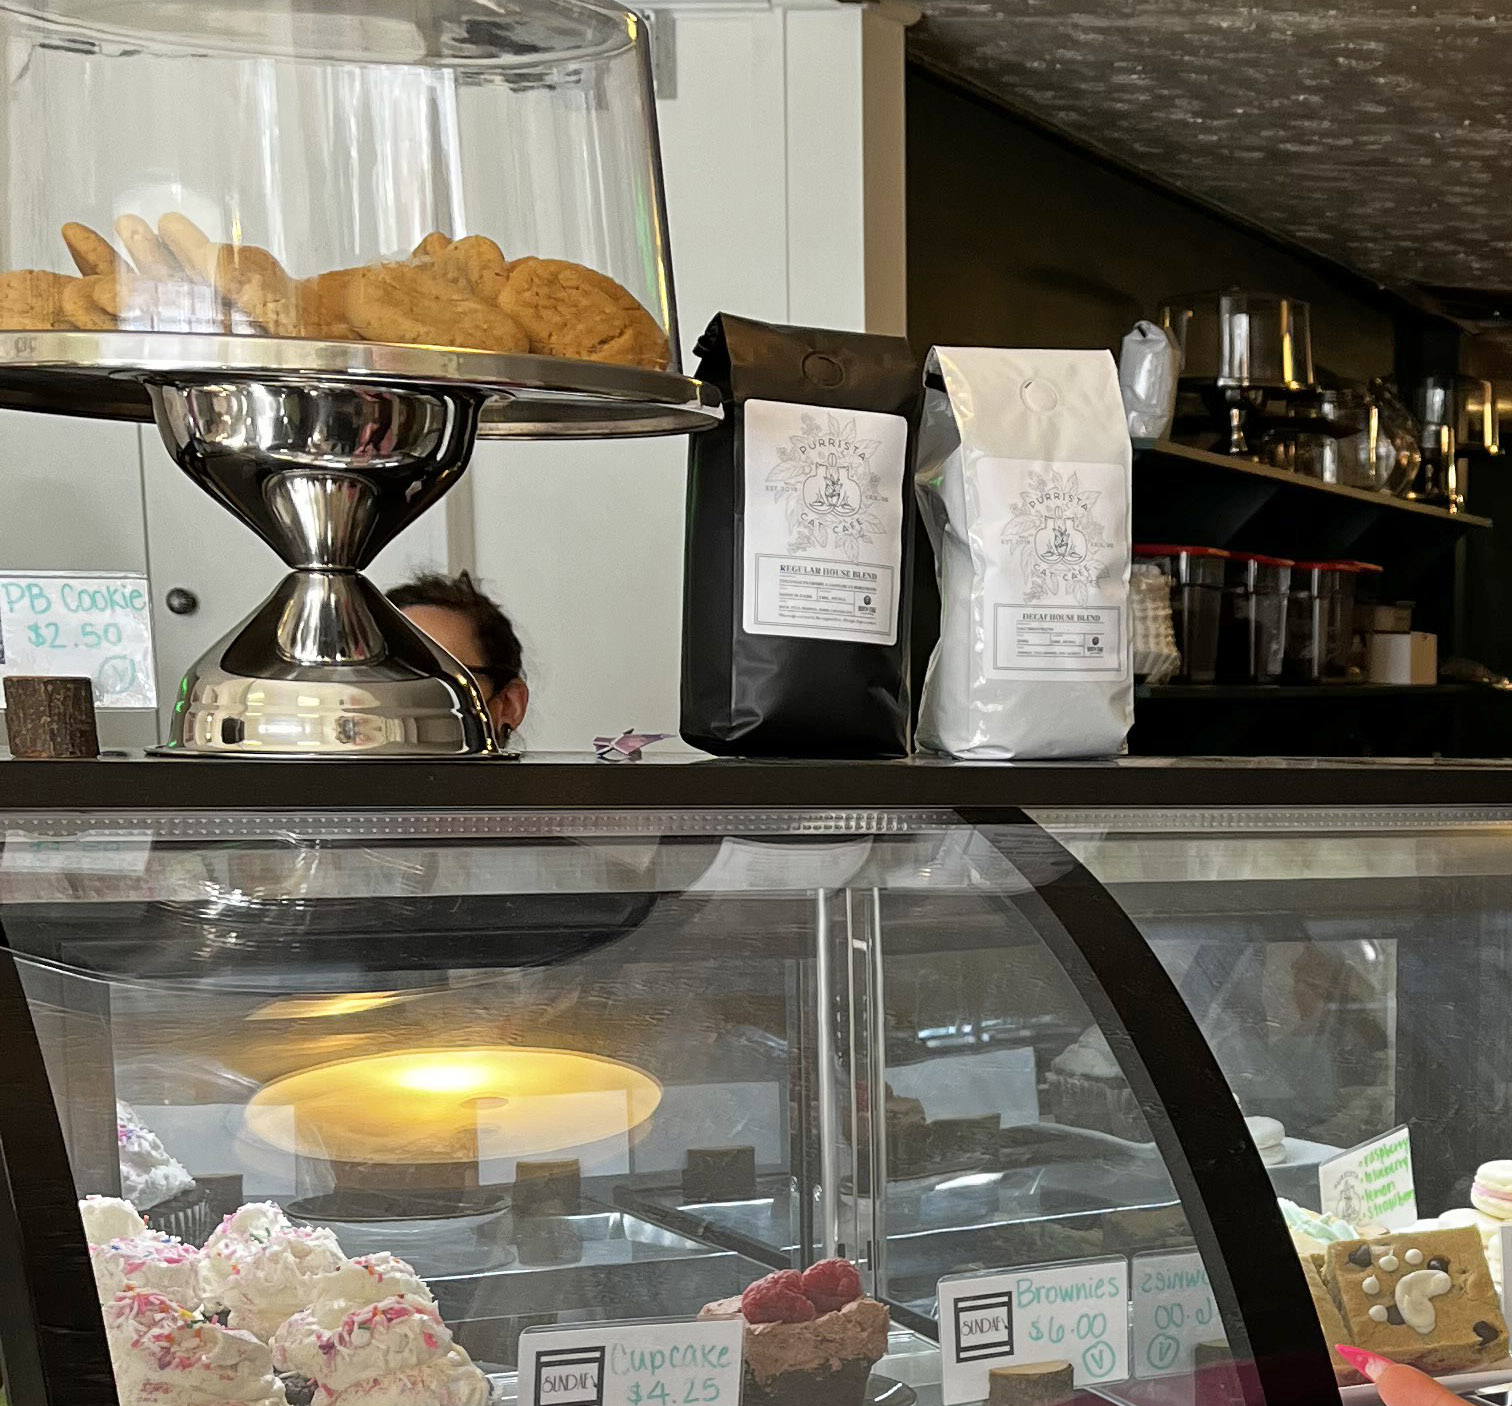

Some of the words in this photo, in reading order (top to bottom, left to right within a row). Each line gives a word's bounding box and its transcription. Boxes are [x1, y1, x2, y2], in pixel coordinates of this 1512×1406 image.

[799, 438, 867, 461] PURRISTA
[1029, 492, 1088, 511] PURRISTA
[800, 512, 824, 528] CAT
[832, 518, 864, 534] CAFE
[780, 564, 822, 574] REGULAR
[823, 568, 851, 578] HOUSE
[852, 571, 878, 580] BLEND
[1033, 564, 1055, 578] CAT
[2, 583, 51, 614] PB
[61, 583, 147, 612] Cookie
[27, 622, 122, 649] $2.50
[1016, 1275, 1119, 1309] Brownies
[961, 1316, 1001, 1336] SUNDAE
[1029, 1313, 1107, 1343] $6.00
[611, 1342, 732, 1376] Cupcake
[542, 1373, 590, 1393] SUNDAE
[627, 1377, 720, 1406] $4.25
